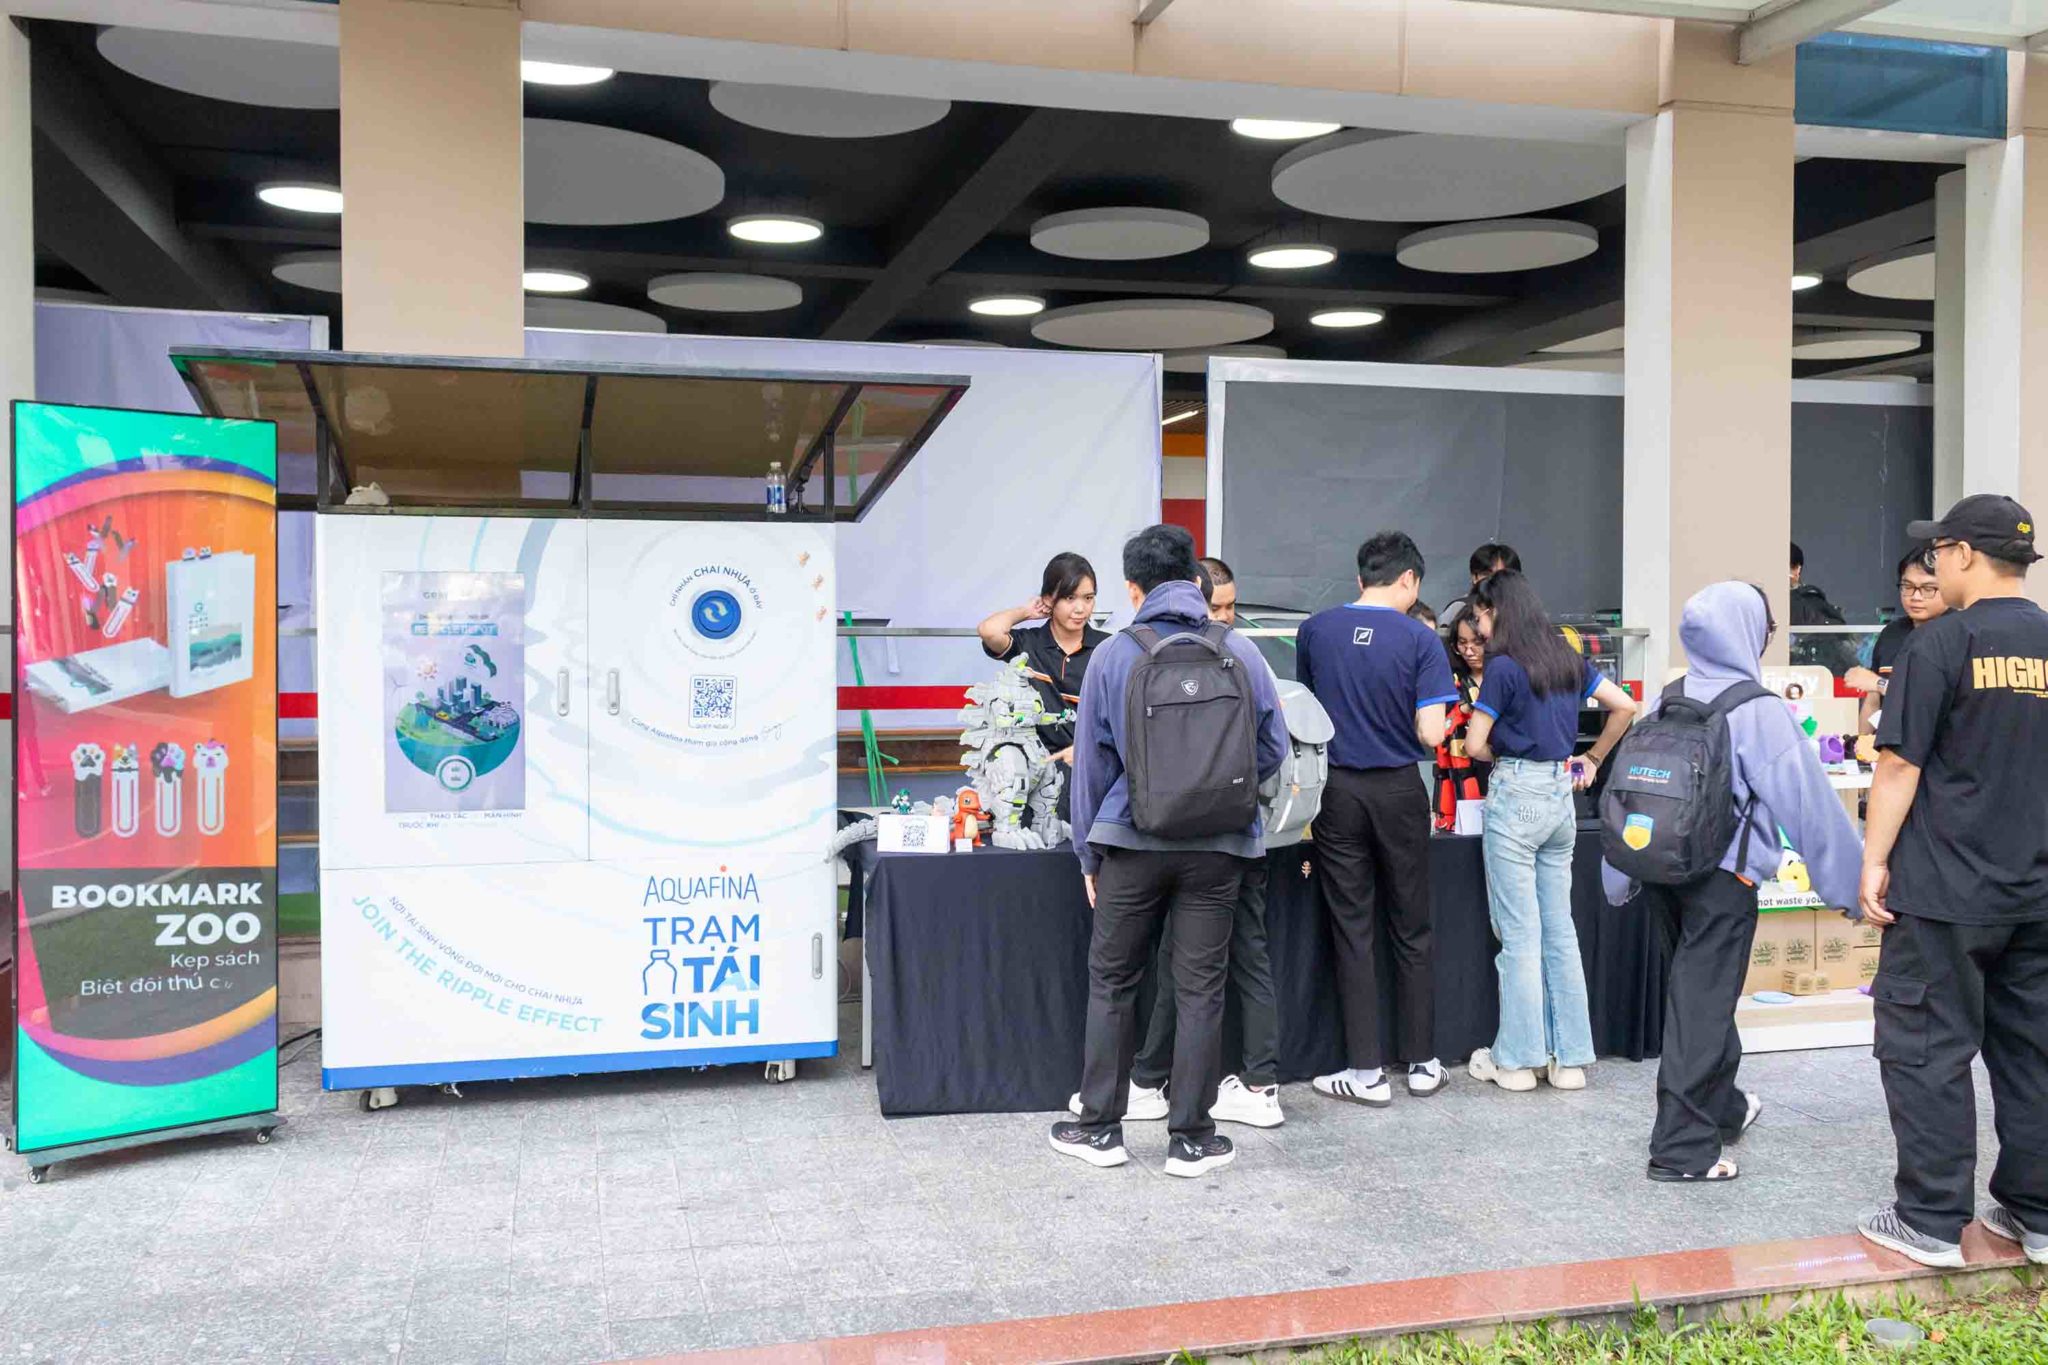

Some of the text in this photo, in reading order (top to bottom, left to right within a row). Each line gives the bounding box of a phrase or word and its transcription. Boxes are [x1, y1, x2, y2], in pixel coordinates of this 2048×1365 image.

[693, 565, 720, 577] CHAI
[722, 566, 752, 588] NHỰA
[1972, 656, 2048, 689] HIGH
[1629, 765, 1671, 779] HUTECH
[52, 882, 263, 909] BOOKMARK
[643, 864, 760, 907] AQUAFINA
[1776, 897, 1803, 906] waste
[154, 911, 261, 946] ZOO
[643, 914, 760, 951] TRẠM
[214, 950, 260, 966] sách
[352, 896, 603, 1033] JOIN THE RIPPLE EFFECT
[682, 946, 760, 993] TÁI
[167, 973, 203, 991] thú
[504, 978, 527, 993] CHO
[528, 987, 552, 1000] CHAI
[640, 999, 759, 1040] SINH
